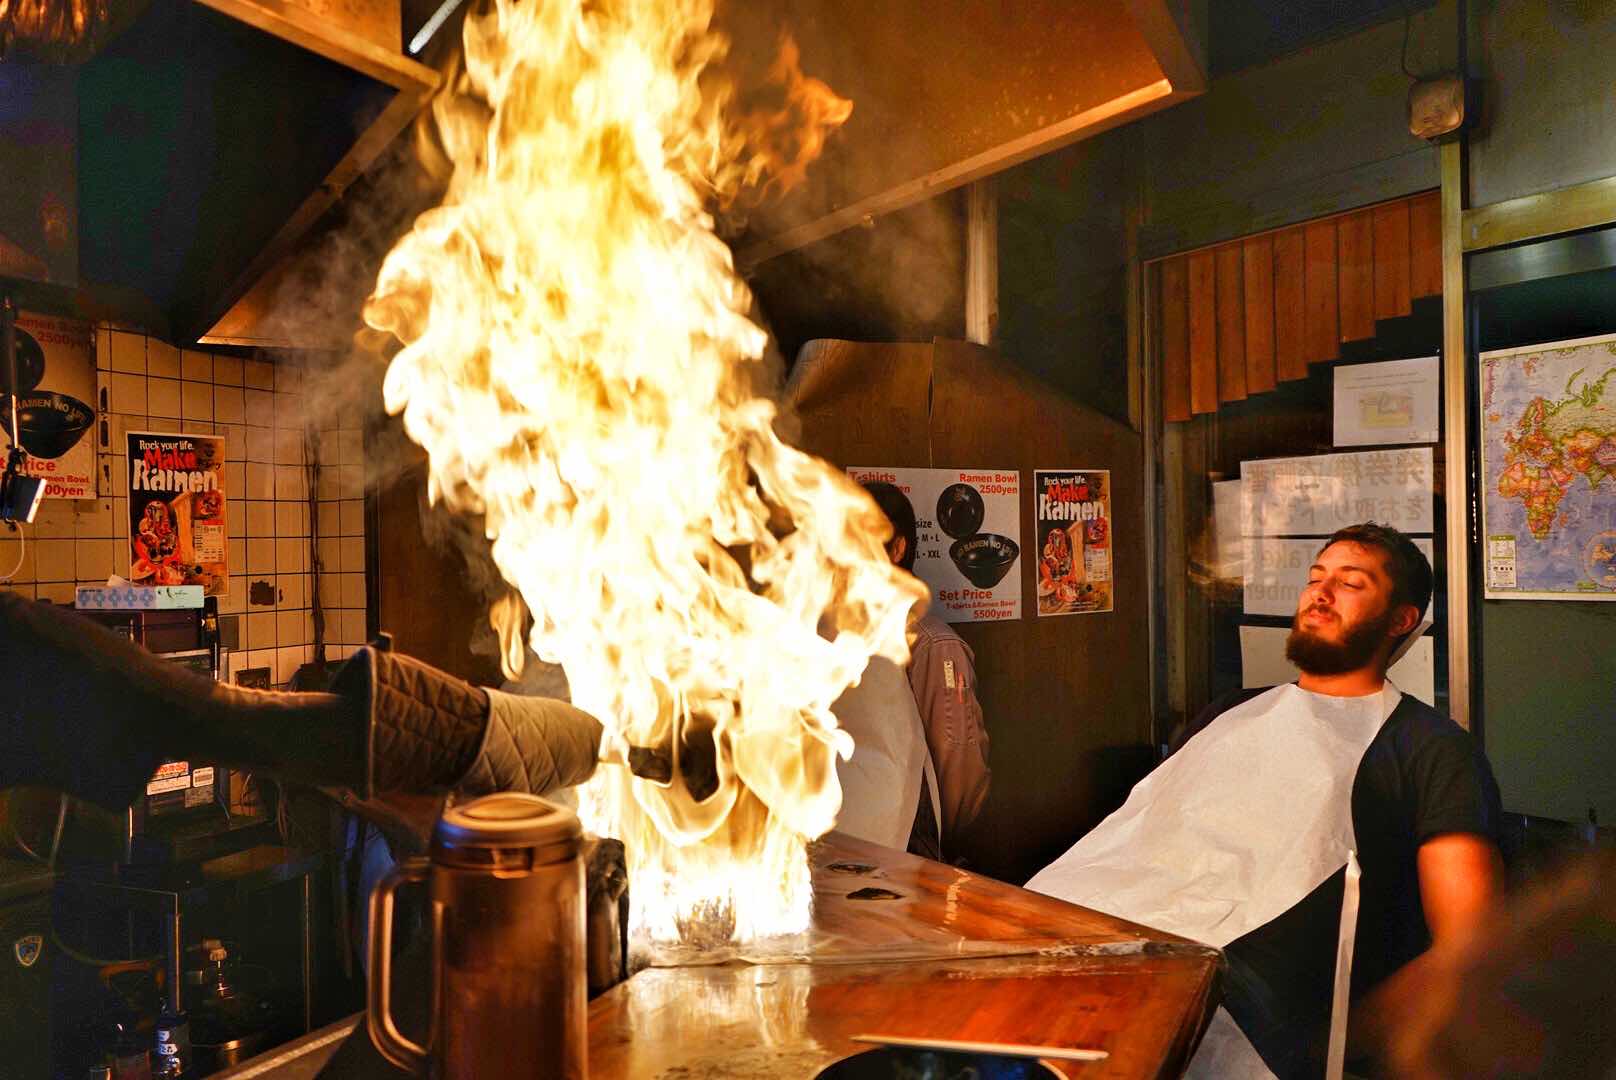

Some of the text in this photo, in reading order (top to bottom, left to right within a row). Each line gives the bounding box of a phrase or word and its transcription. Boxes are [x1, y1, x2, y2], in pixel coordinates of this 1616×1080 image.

[139, 440, 160, 451] Rock
[161, 442, 178, 452] your
[144, 447, 199, 470] Make
[24, 458, 56, 472] rice
[959, 473, 1017, 483] Ramen Bowl
[45, 485, 84, 498] 00yen
[979, 484, 1018, 496] 2500yen
[939, 588, 993, 601] Set Price
[973, 609, 1013, 620] 5500yen
